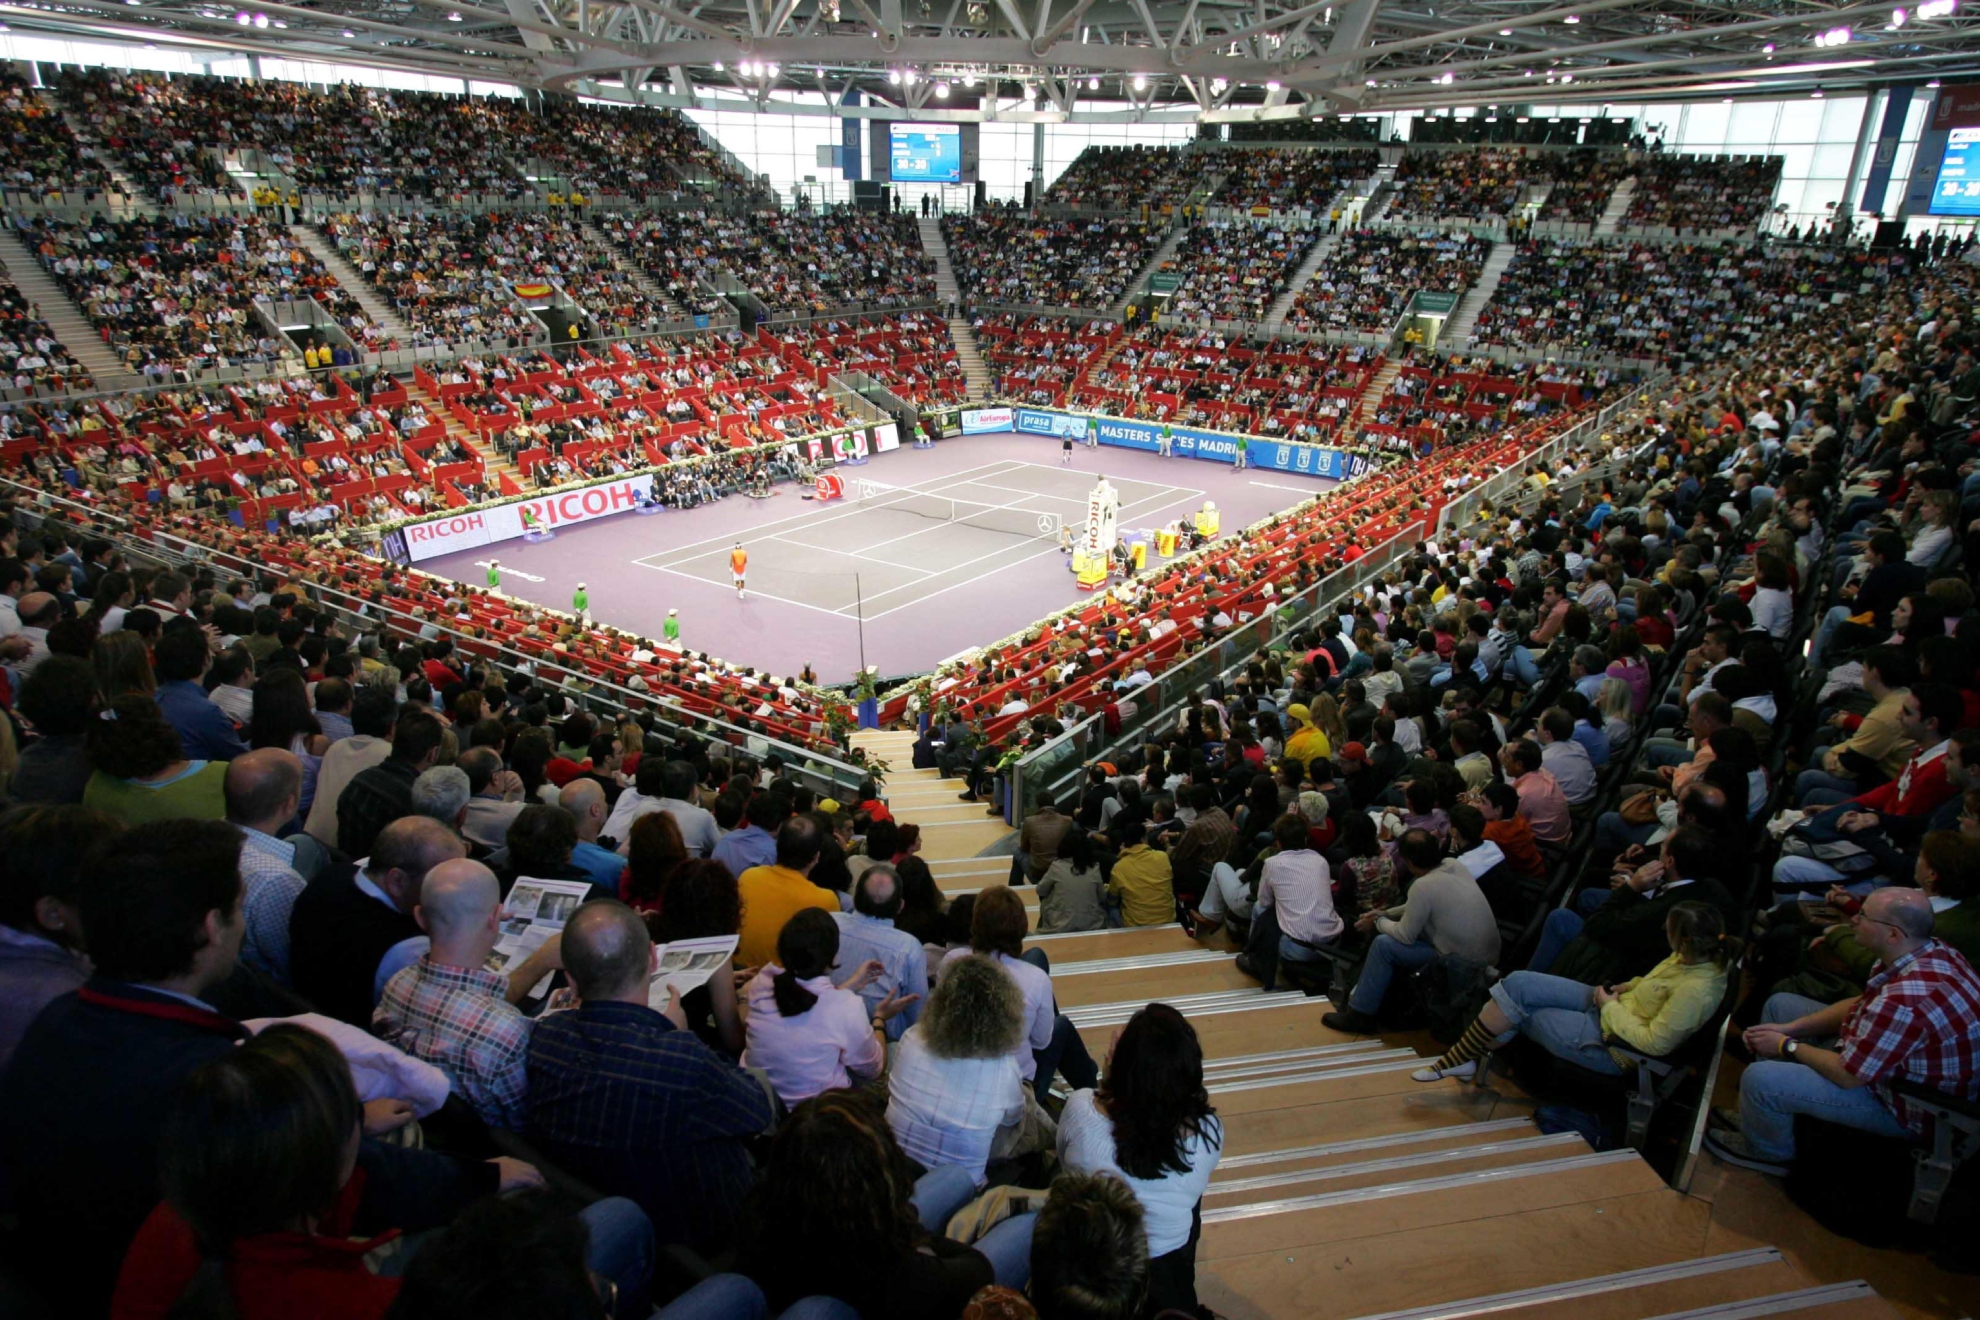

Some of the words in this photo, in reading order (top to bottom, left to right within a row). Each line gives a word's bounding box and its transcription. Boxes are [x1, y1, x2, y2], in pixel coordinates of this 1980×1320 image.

[1023, 415, 1050, 427] prasa
[1100, 425, 1151, 443] MASTERS
[1199, 439, 1238, 455] MADRI
[517, 482, 635, 531] RICOH
[410, 514, 484, 543] RICOH
[1089, 501, 1100, 549] RICOH
